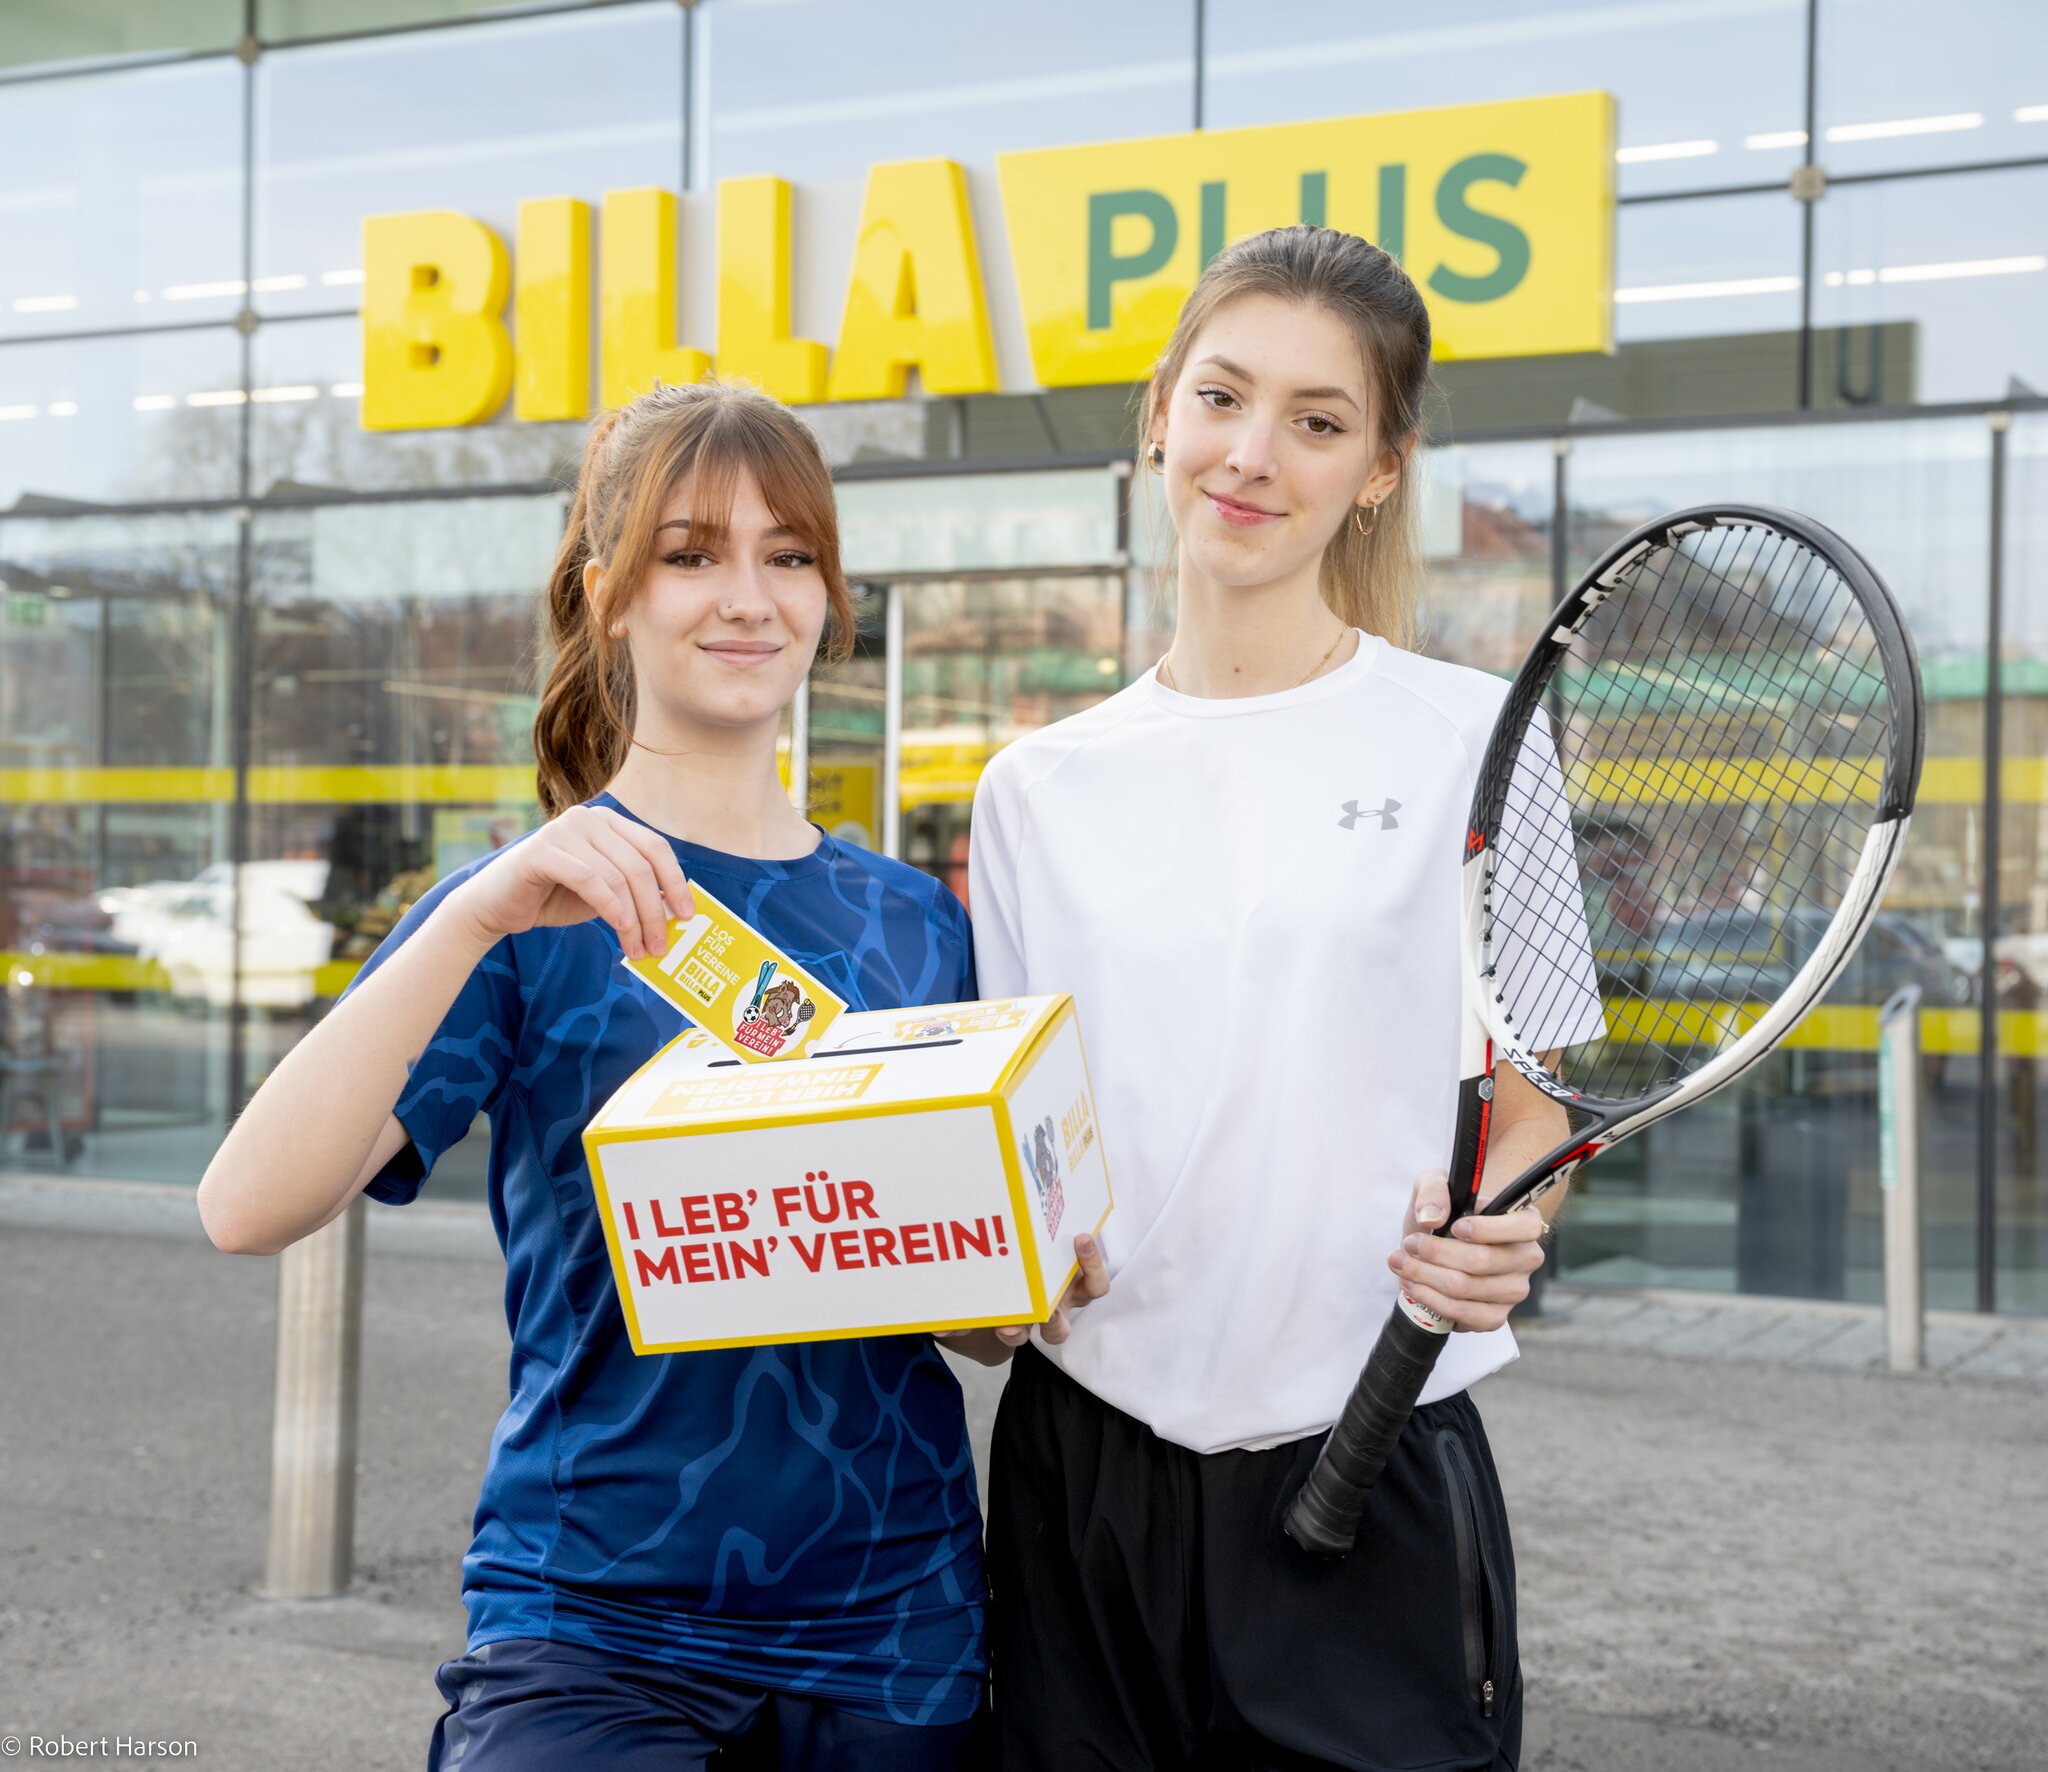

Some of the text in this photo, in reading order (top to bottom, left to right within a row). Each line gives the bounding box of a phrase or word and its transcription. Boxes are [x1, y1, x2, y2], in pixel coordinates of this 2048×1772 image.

[361, 156, 1000, 432] BILLA
[657, 914, 714, 977] 1
[703, 935, 726, 957] FÜR
[711, 925, 735, 946] LOS
[685, 961, 721, 995] BILLA
[697, 945, 741, 986] VEREINE
[678, 973, 711, 1002] BILLA PLUS
[738, 1032, 774, 1055] VEREIN!
[669, 1067, 872, 1098] EINWERFEN
[1503, 1047, 1573, 1097] SPEED
[683, 1083, 861, 1110] HIER LOSE
[622, 1202, 641, 1240] I
[772, 1170, 880, 1227] FÜR
[788, 1215, 1010, 1273] VEREIN!
